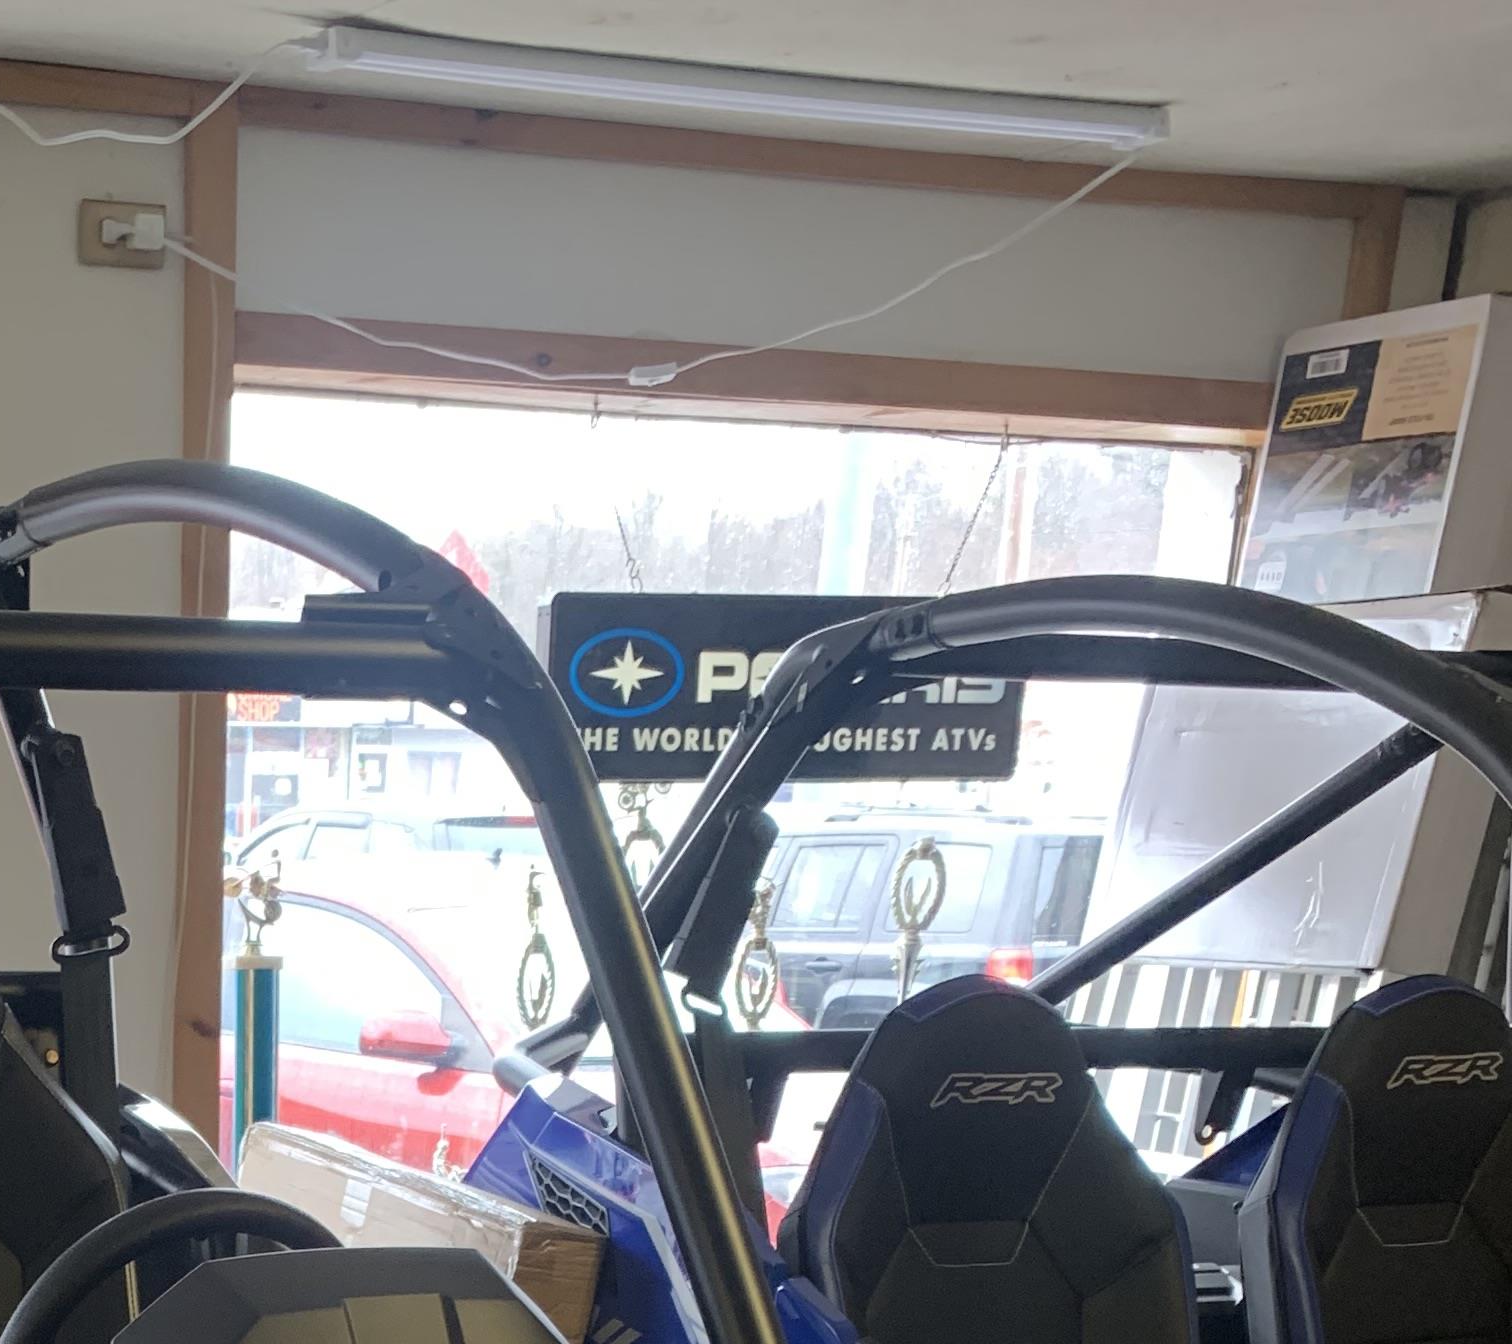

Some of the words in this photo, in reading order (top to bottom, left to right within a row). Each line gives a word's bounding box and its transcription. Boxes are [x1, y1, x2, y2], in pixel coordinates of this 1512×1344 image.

[1286, 399, 1350, 426] MOOSE
[580, 726, 620, 752] HE
[812, 726, 922, 753] UGHEST
[929, 727, 998, 752] ATVs
[1386, 1051, 1503, 1092] RZR
[929, 1071, 1065, 1108] RZR
